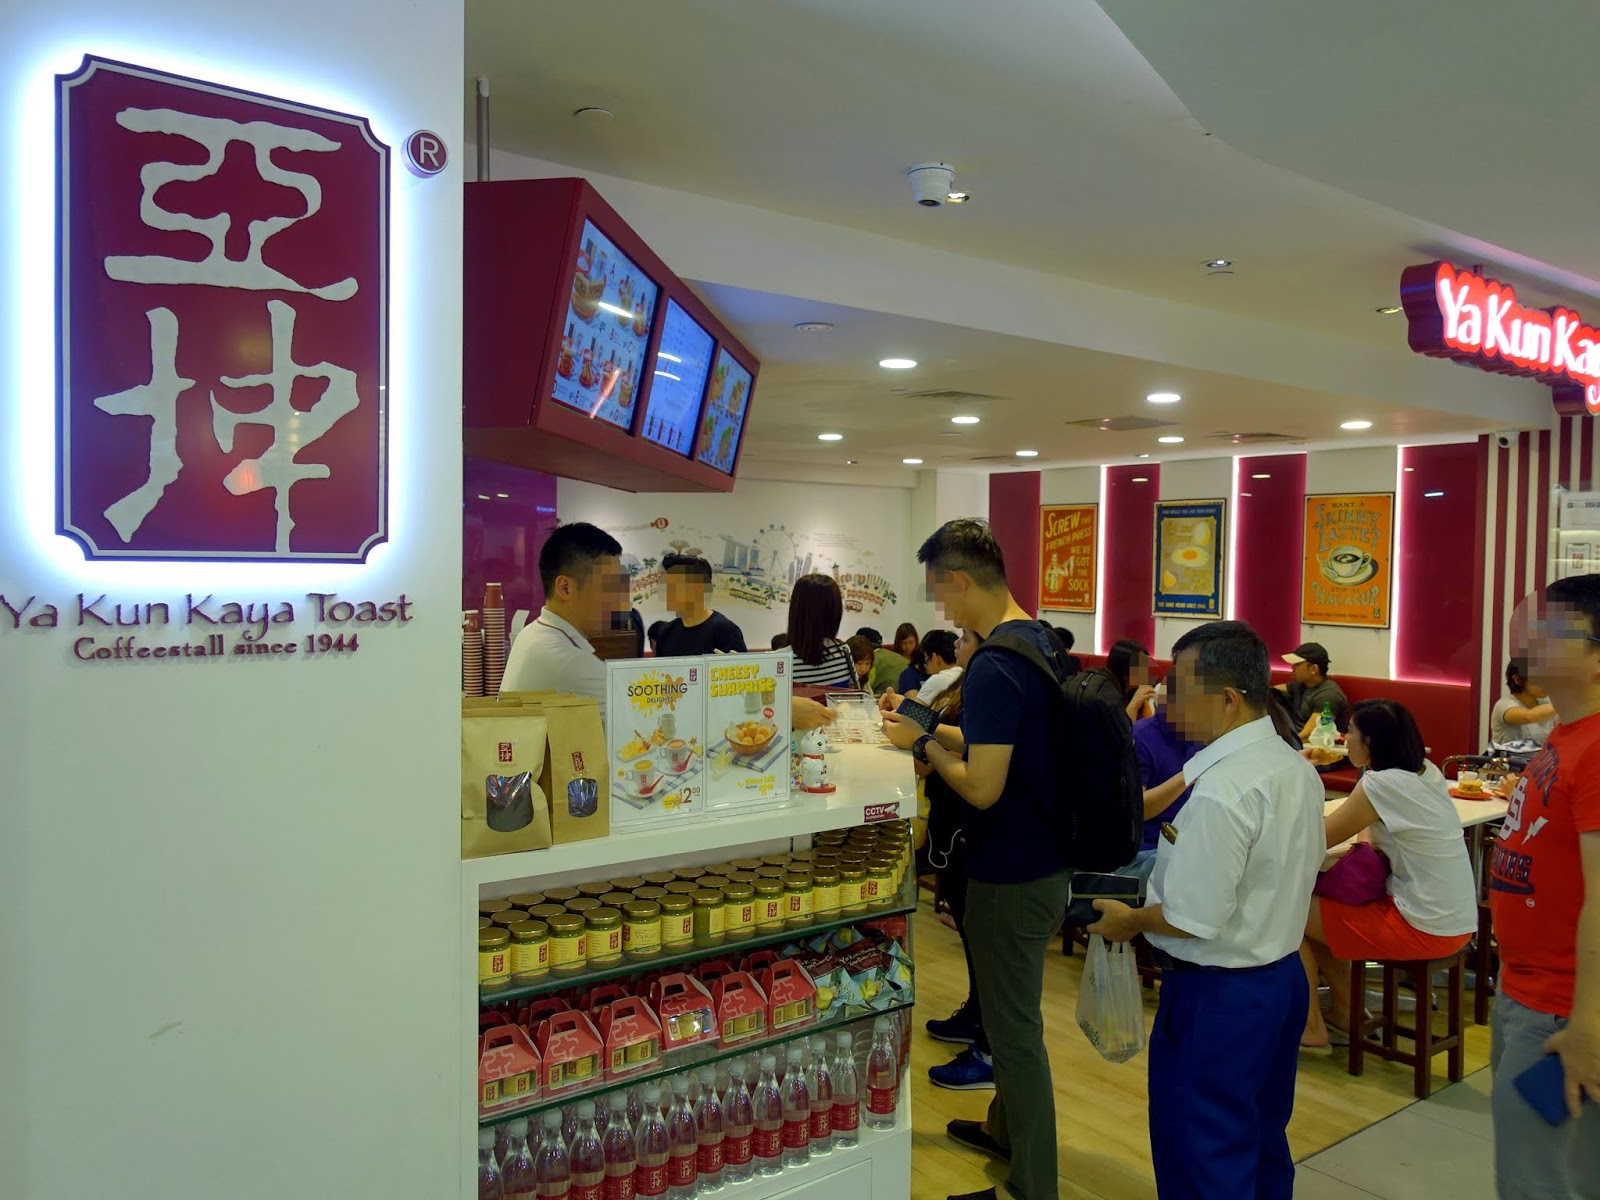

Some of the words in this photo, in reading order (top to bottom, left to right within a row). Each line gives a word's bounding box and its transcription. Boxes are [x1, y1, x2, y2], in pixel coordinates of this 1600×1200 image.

[1439, 278, 1482, 346] Ya
[1485, 294, 1552, 364] Kun
[1045, 511, 1080, 538] SCREW
[1314, 503, 1381, 531] SKINNY
[1319, 525, 1381, 552] LATTE?
[1076, 557, 1090, 566] GOT
[1068, 578, 1090, 591] SOCK
[0, 594, 57, 629] Ya
[77, 592, 169, 626] Kun
[185, 592, 295, 642] Kaya
[305, 592, 414, 623] Toast
[73, 633, 225, 661] Coffeestall
[233, 641, 298, 655] since
[305, 632, 360, 653] 1944
[710, 664, 760, 682] CHEESY
[627, 682, 688, 698] SOOTHING
[710, 677, 775, 698] SURPRISE
[865, 806, 885, 816] CCTV
